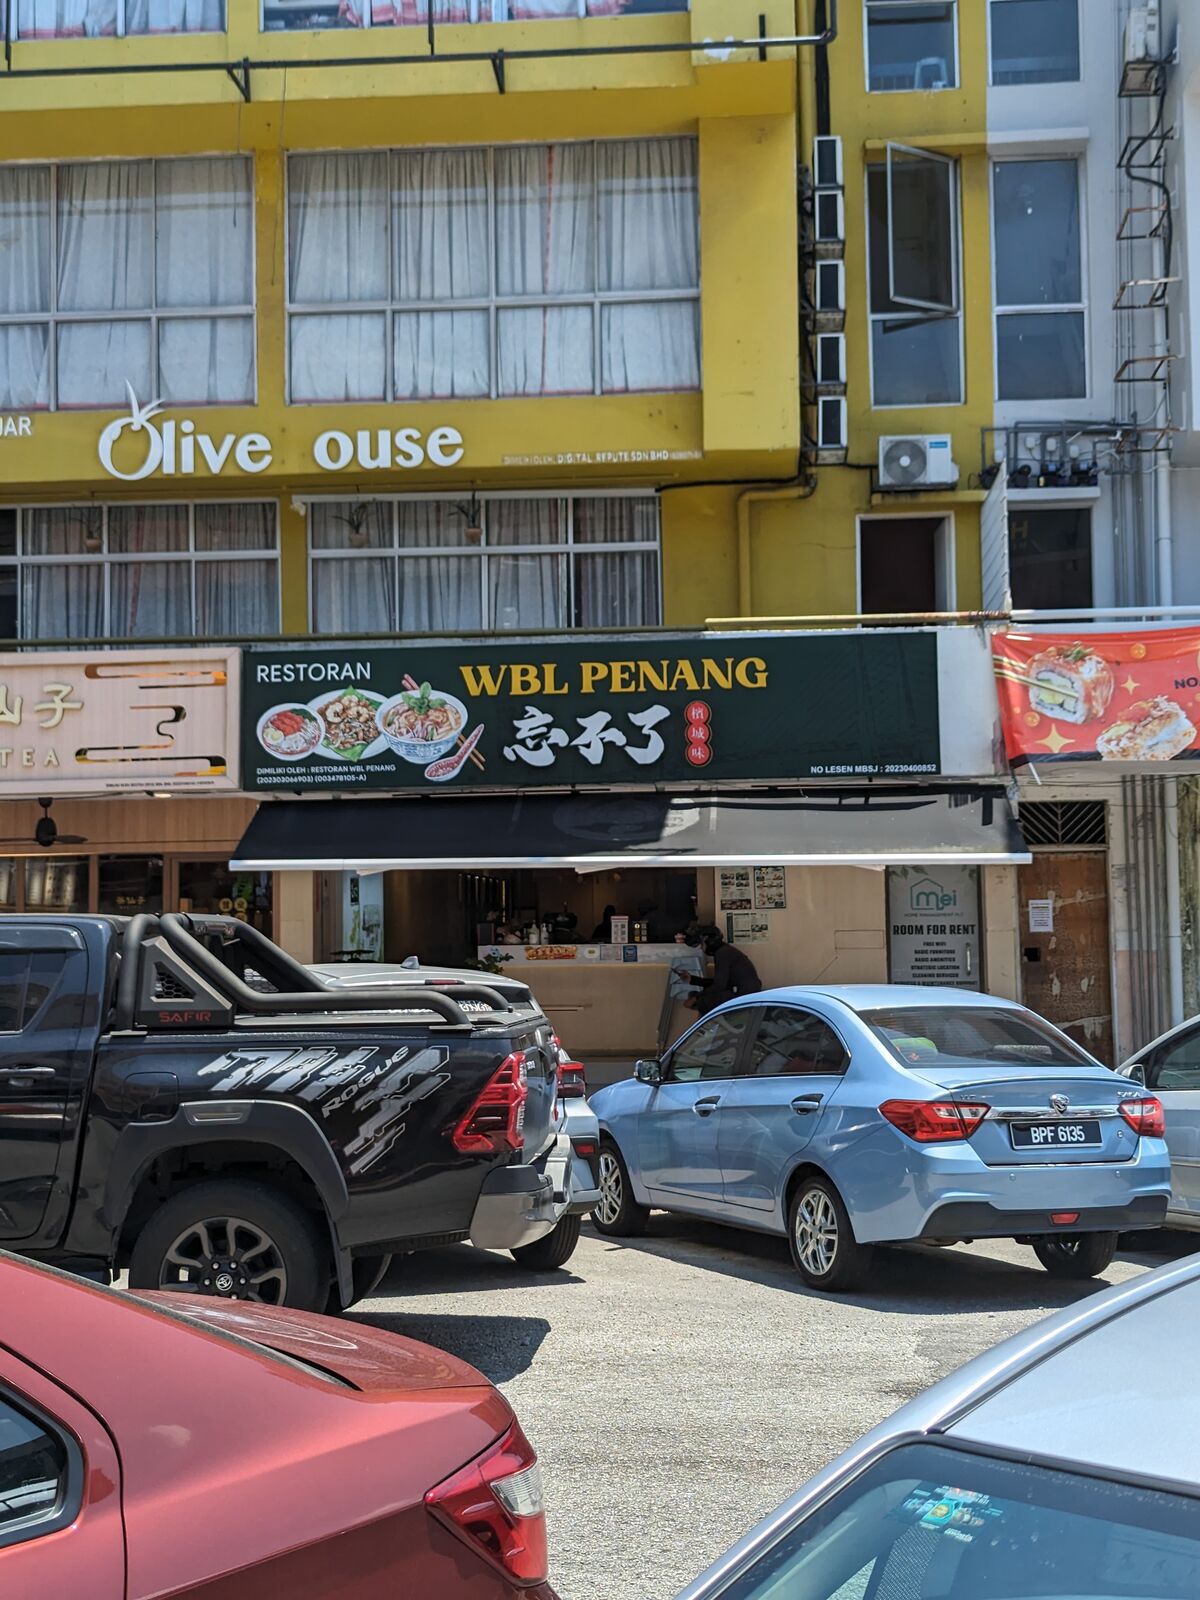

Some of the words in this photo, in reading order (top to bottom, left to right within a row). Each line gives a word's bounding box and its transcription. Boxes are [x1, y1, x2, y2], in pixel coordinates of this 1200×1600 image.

[0, 416, 32, 436] AR
[98, 394, 273, 481] Olive
[313, 425, 466, 471] ouse
[557, 453, 593, 465] DGTAL
[256, 662, 371, 683] RESTORAN
[459, 663, 569, 697] WBL
[579, 656, 769, 694] PENANG
[503, 704, 671, 767] 忘不了
[0, 748, 59, 769] TEA
[256, 767, 286, 776] DIMILIKI
[286, 766, 306, 775] OLEH
[310, 765, 349, 774] RESTORAN
[349, 764, 365, 773] WBL
[365, 763, 397, 773] PENANG
[810, 765, 824, 774] NO
[825, 765, 854, 773] LESEN
[854, 765, 879, 773] MBSJ
[893, 924, 924, 936] ROOM
[926, 924, 947, 936] FOR
[949, 923, 976, 936] RENT
[159, 1010, 212, 1023] SAFIR
[321, 1045, 411, 1118] ROGUE
[1030, 1126, 1055, 1143] BPF
[1057, 1125, 1085, 1142] 6135
